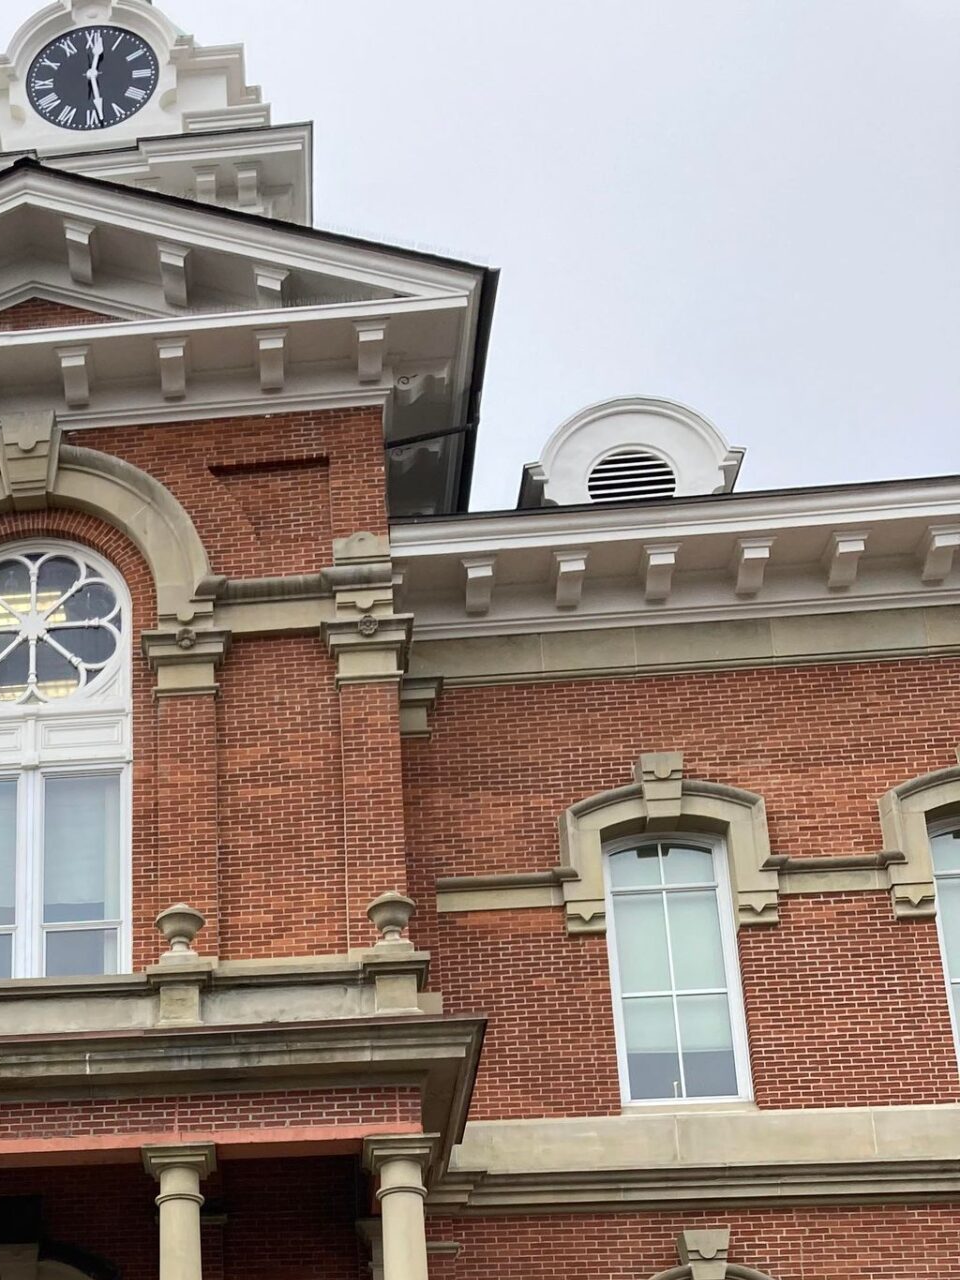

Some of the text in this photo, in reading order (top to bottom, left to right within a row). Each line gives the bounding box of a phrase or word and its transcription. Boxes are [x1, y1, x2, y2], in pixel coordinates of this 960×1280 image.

[59, 40, 77, 57] XI
[112, 33, 124, 51] I
[126, 48, 145, 61] II
[41, 58, 61, 70] X
[132, 68, 152, 78] III
[111, 103, 125, 117] V
